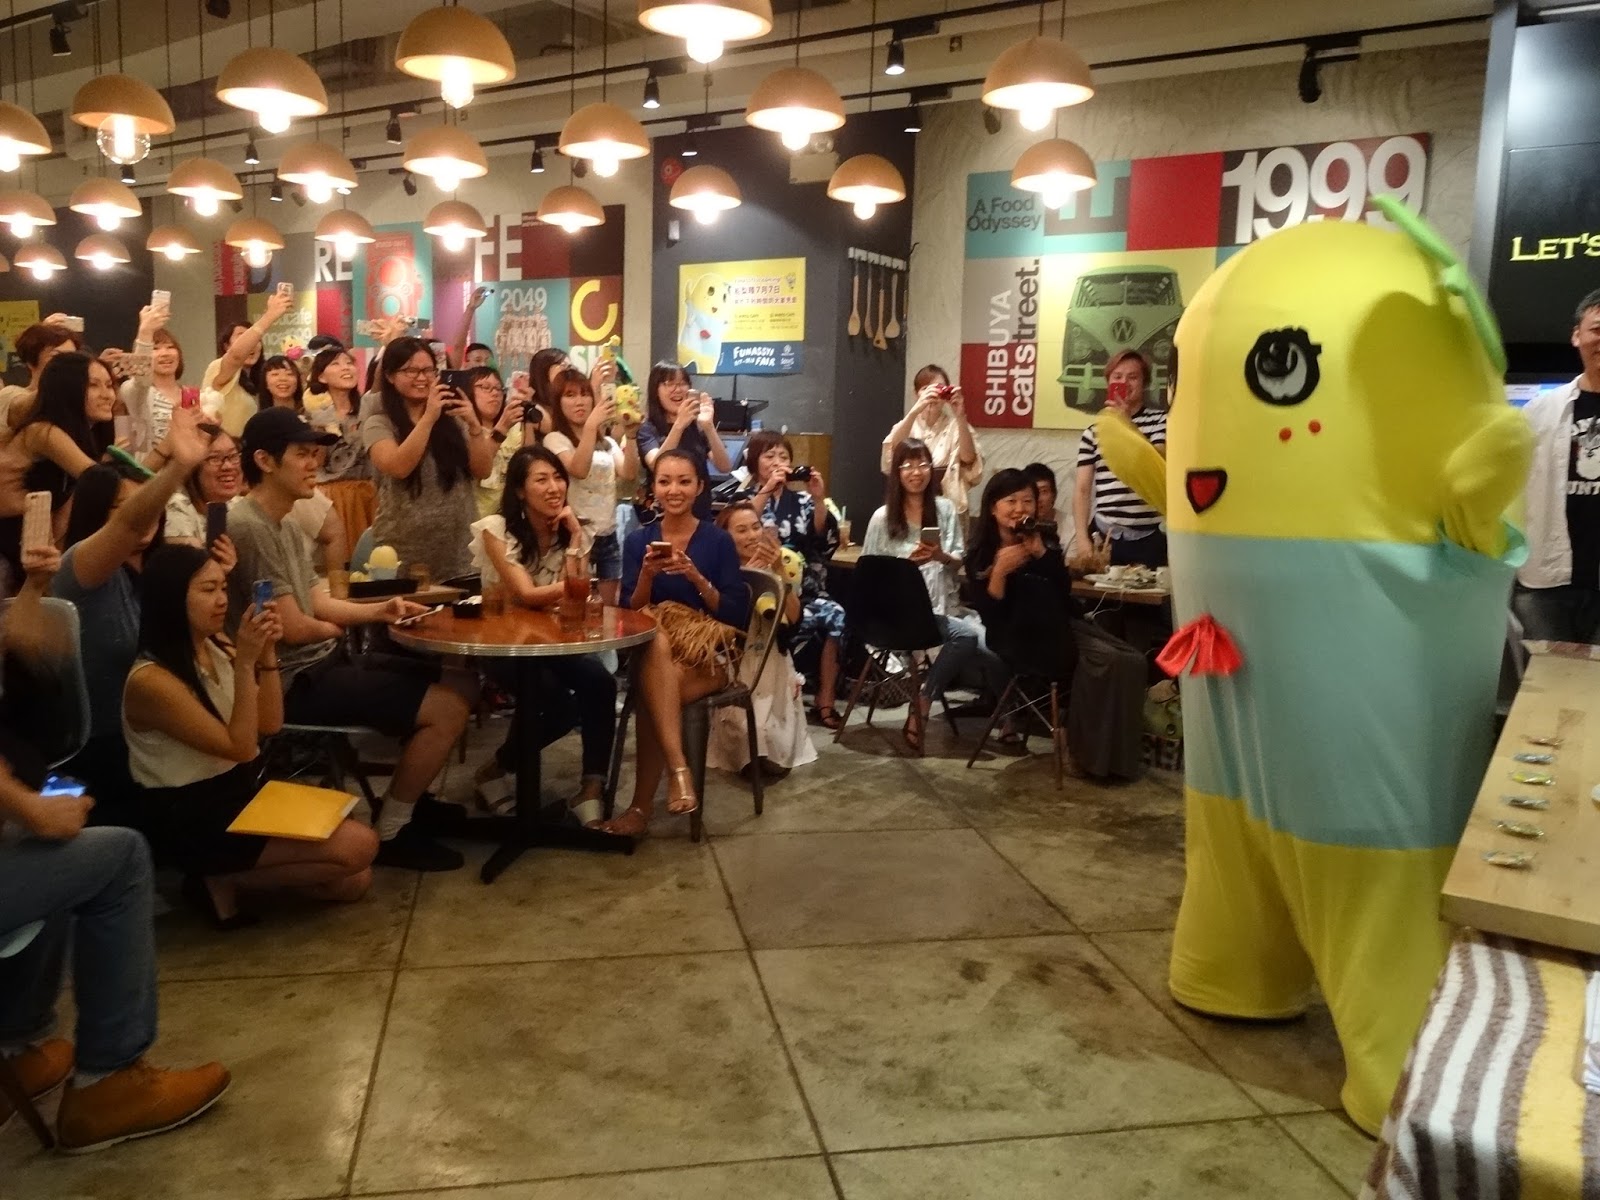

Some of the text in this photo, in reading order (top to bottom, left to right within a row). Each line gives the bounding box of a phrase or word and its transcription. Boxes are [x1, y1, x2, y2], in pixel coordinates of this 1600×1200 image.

[1222, 136, 1427, 244] 1999
[973, 195, 1035, 213] A Food
[966, 213, 1041, 234] Odyssey
[1509, 232, 1600, 262] LET'S
[500, 287, 548, 312] 2049
[984, 289, 1012, 416] SHIBUYA
